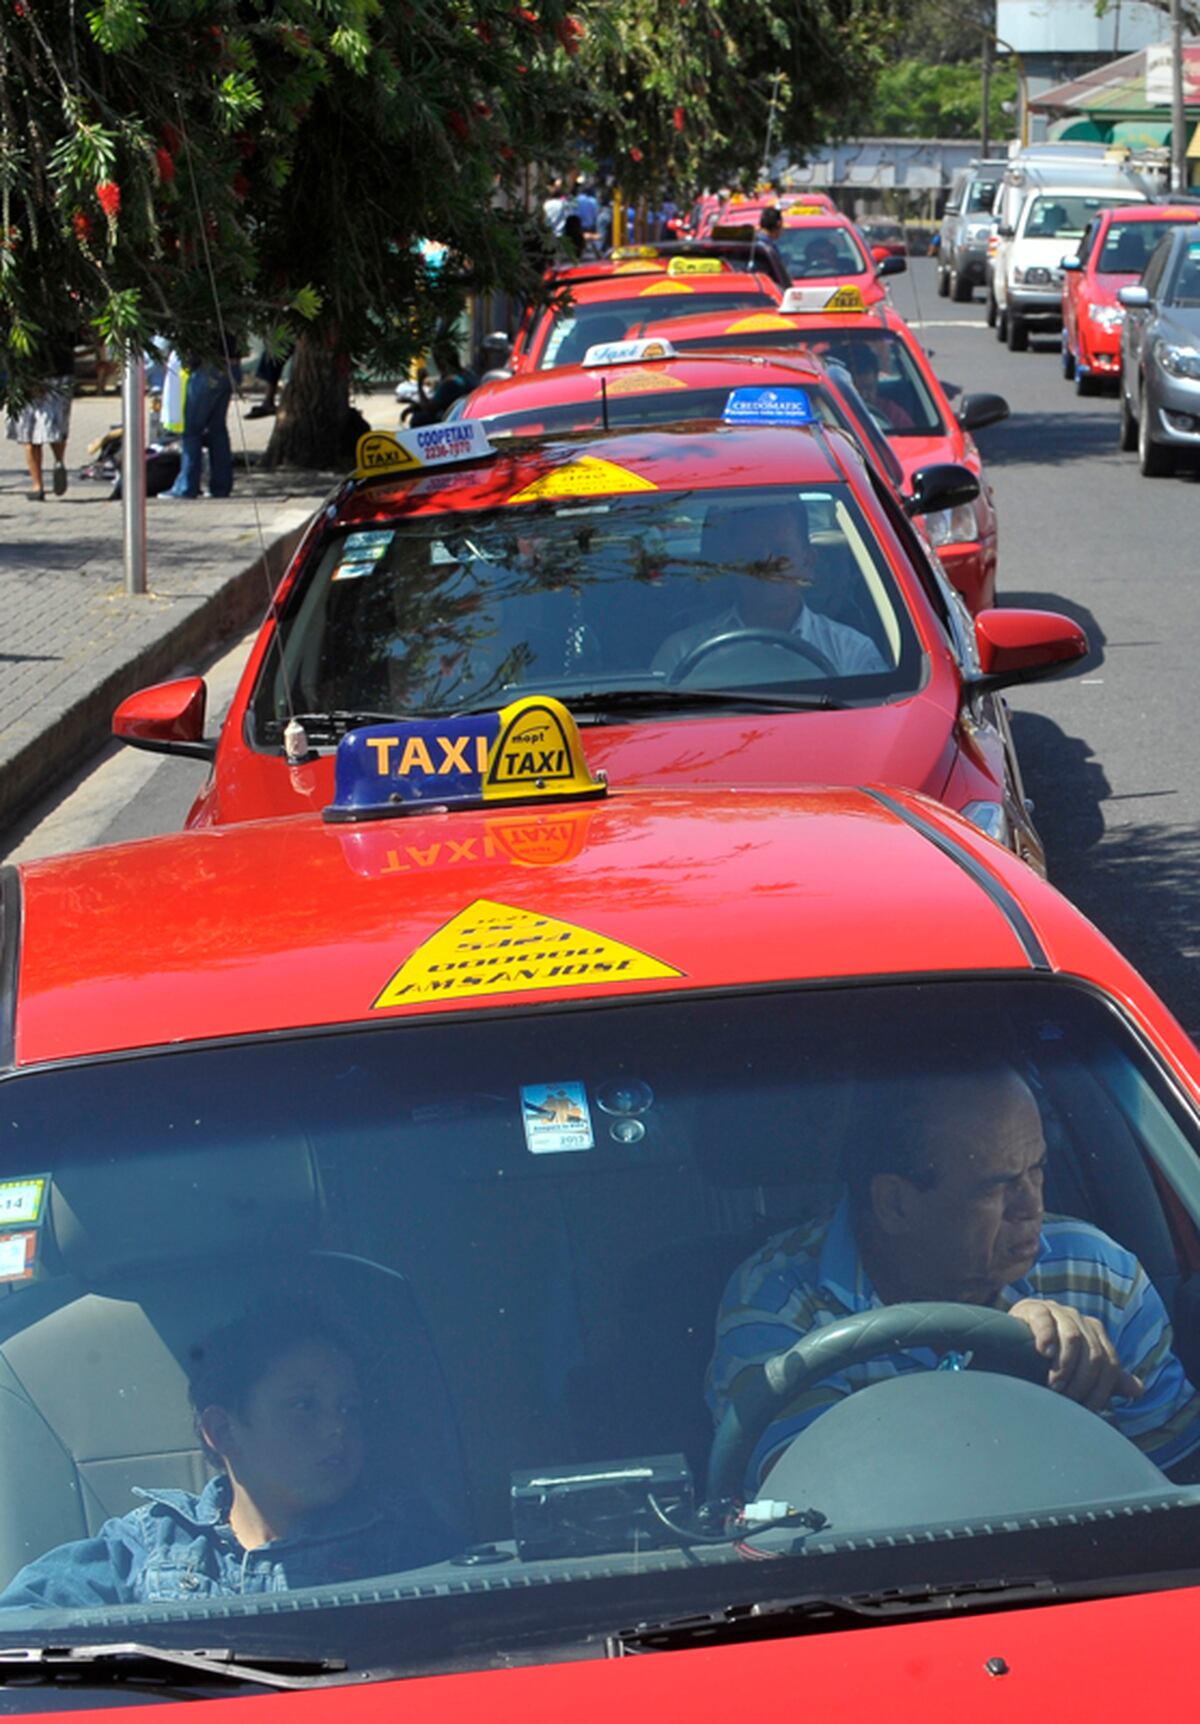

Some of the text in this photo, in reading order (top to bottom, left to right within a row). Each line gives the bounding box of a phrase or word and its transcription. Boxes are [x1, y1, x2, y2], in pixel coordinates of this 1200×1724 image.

[417, 425, 474, 448] COOPETAXI
[367, 451, 400, 464] TAXI
[366, 736, 488, 775] TAXI
[504, 750, 565, 776] TAXI
